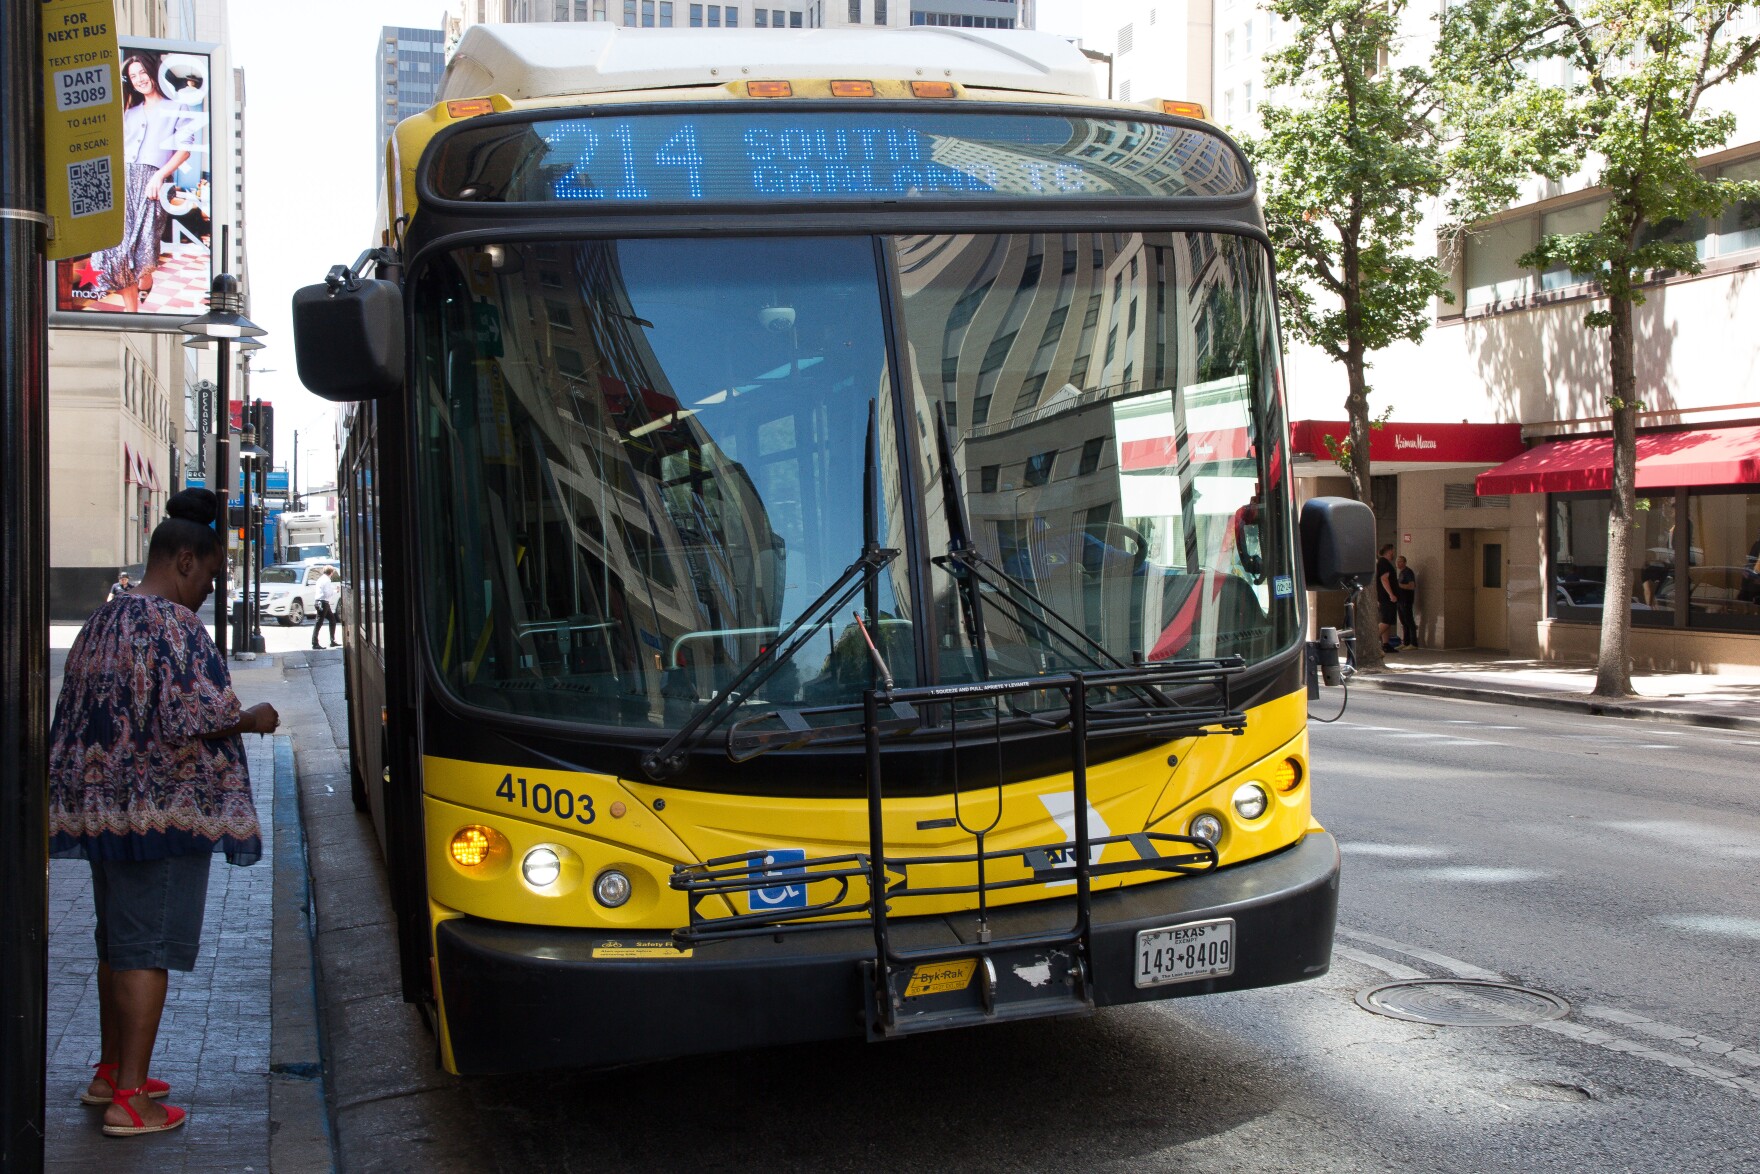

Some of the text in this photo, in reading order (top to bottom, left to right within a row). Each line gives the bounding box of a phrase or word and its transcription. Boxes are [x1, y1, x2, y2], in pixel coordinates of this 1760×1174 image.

[63, 12, 88, 26] FOR
[47, 24, 107, 43] NEXT BUS
[48, 49, 113, 67] TEXT STOP ID:
[63, 68, 103, 88] DART
[63, 86, 106, 106] 33089
[67, 113, 107, 129] TO 41411
[69, 137, 109, 153] OR SCAN:
[743, 128, 921, 161] SOUTH
[548, 123, 703, 198] 214
[752, 164, 999, 193] GARLAND
[935, 687, 959, 695] SQUEEZE
[495, 772, 596, 825] 41003
[1168, 926, 1206, 941] TEXAS
[1174, 937, 1198, 945] EXEMPT
[920, 968, 964, 984] Byk-Rak
